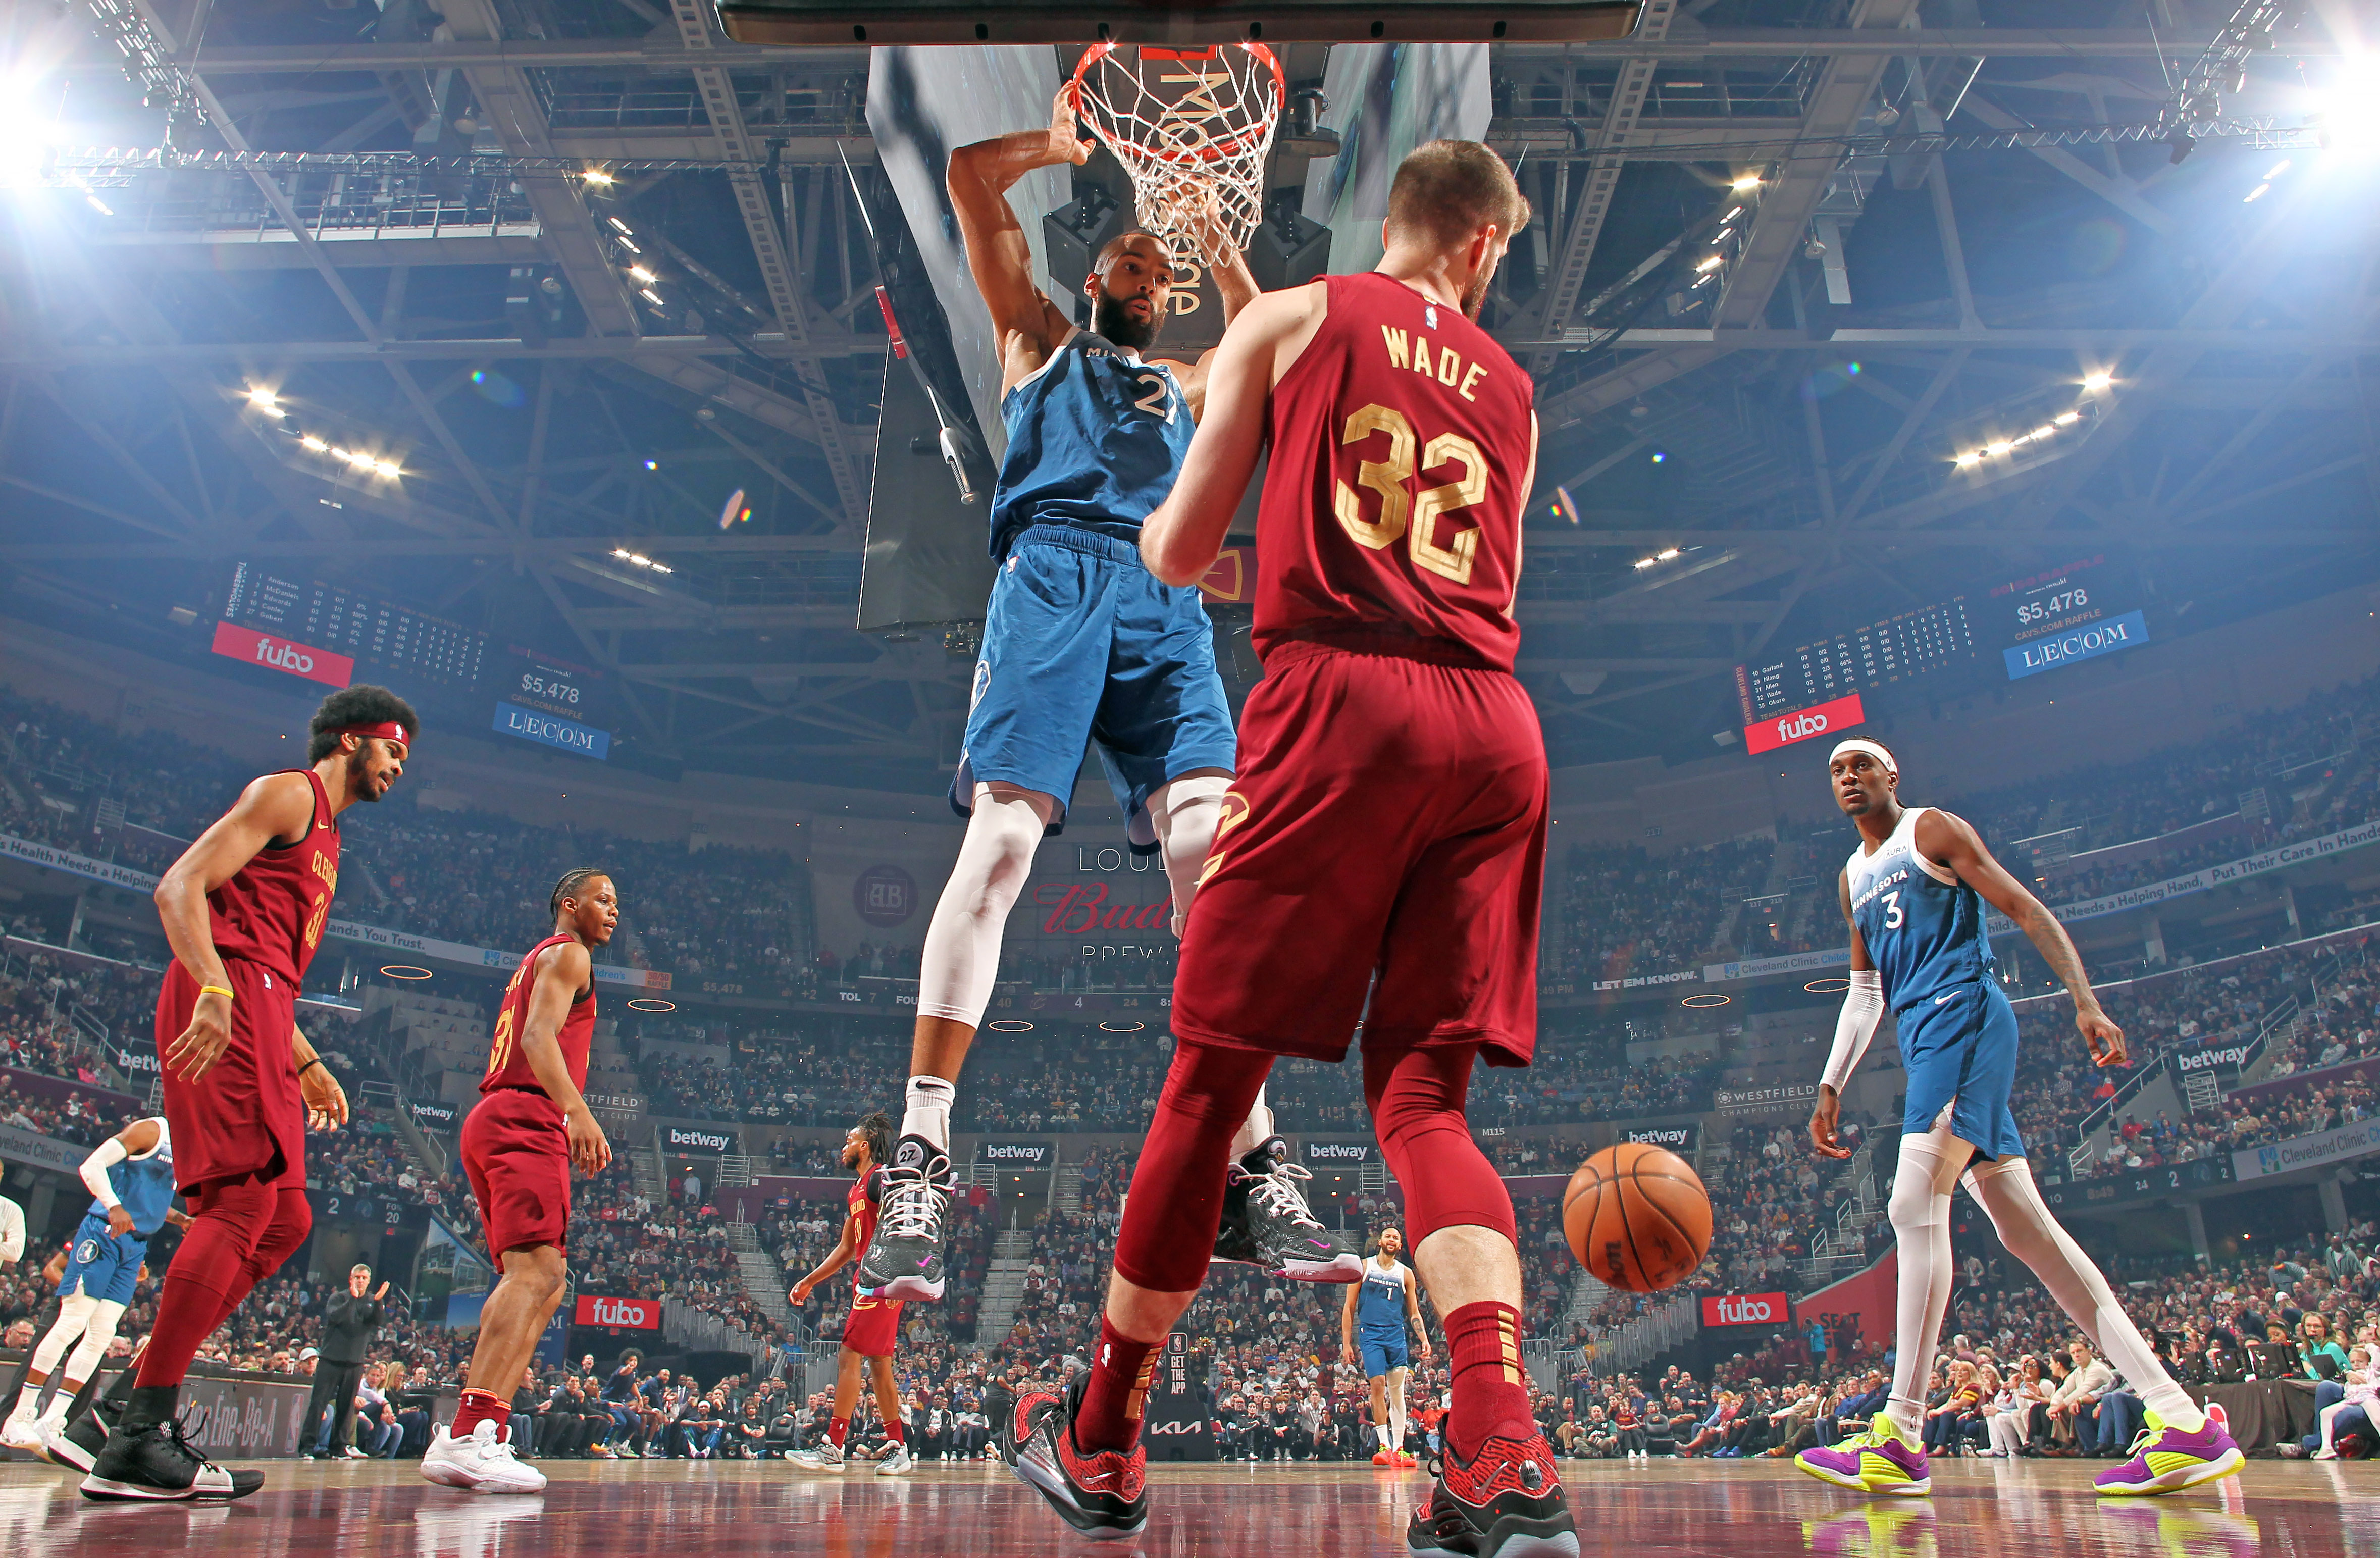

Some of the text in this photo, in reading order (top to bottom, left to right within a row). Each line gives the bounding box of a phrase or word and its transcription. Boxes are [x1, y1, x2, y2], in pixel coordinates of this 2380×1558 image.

[1381, 324, 1488, 402] WADE
[1334, 403, 1488, 585] 32
[264, 594, 291, 607] Edwards
[2017, 588, 2088, 625] $5,478
[260, 612, 283, 623] Gobert
[256, 639, 314, 673] fubo
[1762, 662, 1783, 673] Garland
[1763, 673, 1780, 682] Niang
[522, 673, 580, 703] $5,478
[1765, 682, 1779, 690] Allen
[1767, 690, 1781, 698] Wade
[1769, 697, 1785, 706] Okoro
[1778, 714, 1828, 741] fubo
[10, 841, 53, 862] Health
[58, 853, 97, 874] Needs
[101, 868, 109, 877] a
[2212, 866, 2236, 881] Put
[2238, 855, 2274, 873] Their
[2279, 846, 2314, 862] Care
[2317, 840, 2334, 852] In
[2066, 902, 2105, 918] Needs
[2108, 900, 2115, 909] a
[2117, 887, 2164, 906] Helping
[2167, 875, 2203, 894] Hand,
[1881, 890, 1904, 929] 3
[324, 925, 425, 950] ands You Trust.
[1742, 961, 1789, 974] Cleveland
[1791, 956, 1818, 968] Clinic
[647, 971, 669, 981] 50/50
[1592, 970, 1697, 991] LET EM KNOW.
[647, 980, 669, 990] RAFFLE
[1558, 984, 1574, 994] PM
[839, 992, 861, 1001] TOL
[869, 992, 877, 1003] 7
[997, 997, 1012, 1008] 40
[1075, 996, 1083, 1009] 4
[1124, 998, 1139, 1007] 24
[119, 1048, 162, 1073] betw
[2178, 1045, 2248, 1071] betway
[1734, 1085, 1814, 1101] WESTFIELD
[413, 1104, 453, 1120] betway
[611, 1113, 637, 1121] CLUB
[1722, 1102, 1816, 1117] CHAMPIONS CLUB
[670, 1128, 729, 1150] betway
[1482, 1128, 1505, 1136] M115
[1628, 1129, 1688, 1145] betway
[33, 1141, 62, 1163] Clinic
[987, 1144, 1045, 1161] betway
[1310, 1144, 1368, 1160] betway
[2282, 1138, 2336, 1164] Cleveland
[2337, 1130, 2367, 1152] Clinic
[899, 1149, 917, 1163] 27
[2048, 1193, 2062, 1204] 1Q
[2136, 1180, 2149, 1191] 24
[2169, 1171, 2180, 1187] 2
[2221, 1168, 2228, 1178] 2
[328, 1197, 340, 1214] 2
[386, 1212, 399, 1223] 20
[1965, 1210, 1972, 1220] 0
[1369, 1277, 1399, 1287] MINNESOTA
[1387, 1287, 1392, 1300] 1
[593, 1298, 645, 1325] fubo
[1718, 1296, 1771, 1322] fubo
[1171, 1355, 1185, 1368] GET
[1171, 1369, 1185, 1381] THE
[1171, 1381, 1186, 1394] APP
